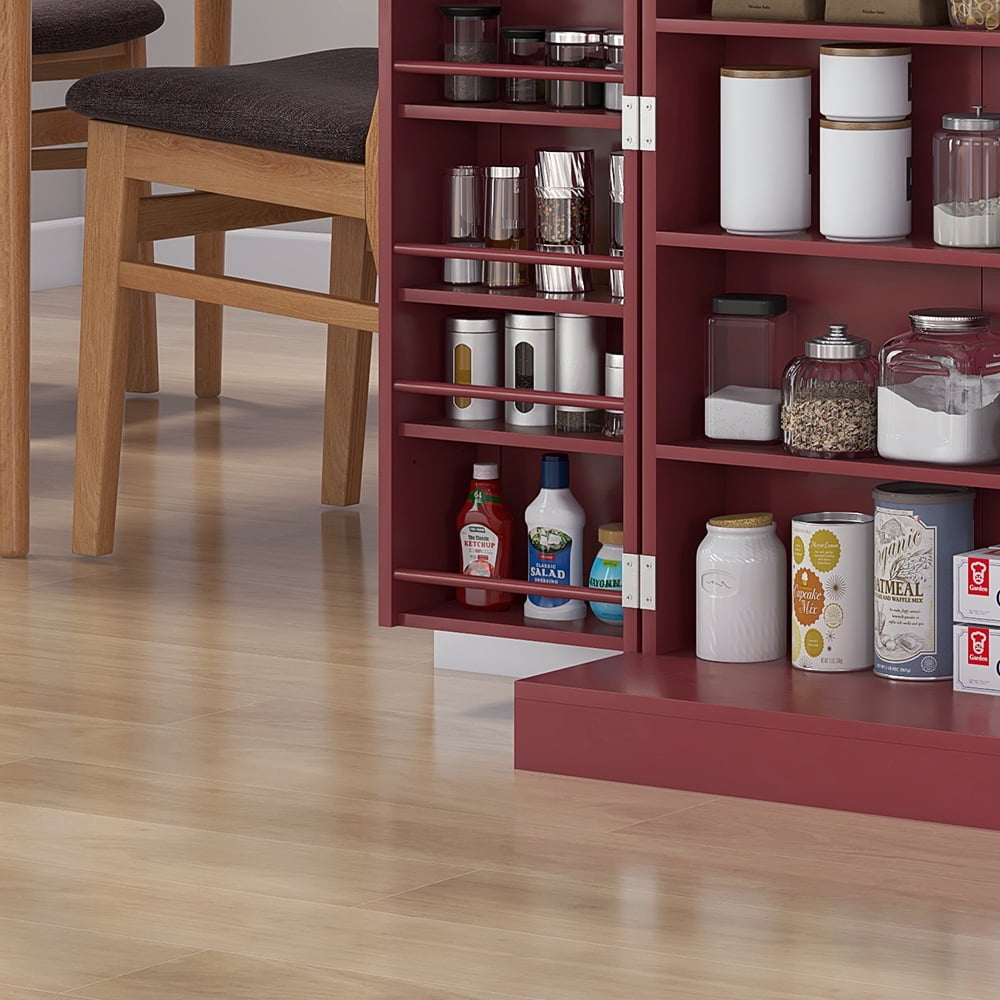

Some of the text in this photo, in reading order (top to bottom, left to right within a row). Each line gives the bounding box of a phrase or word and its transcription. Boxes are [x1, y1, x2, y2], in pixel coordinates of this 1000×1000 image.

[464, 540, 496, 549] KETCHUP
[530, 566, 566, 579] SALAD
[876, 577, 923, 597] ATMEAL
[969, 584, 988, 592] Garden
[799, 599, 818, 615] Mix
[969, 654, 988, 662] Garden
